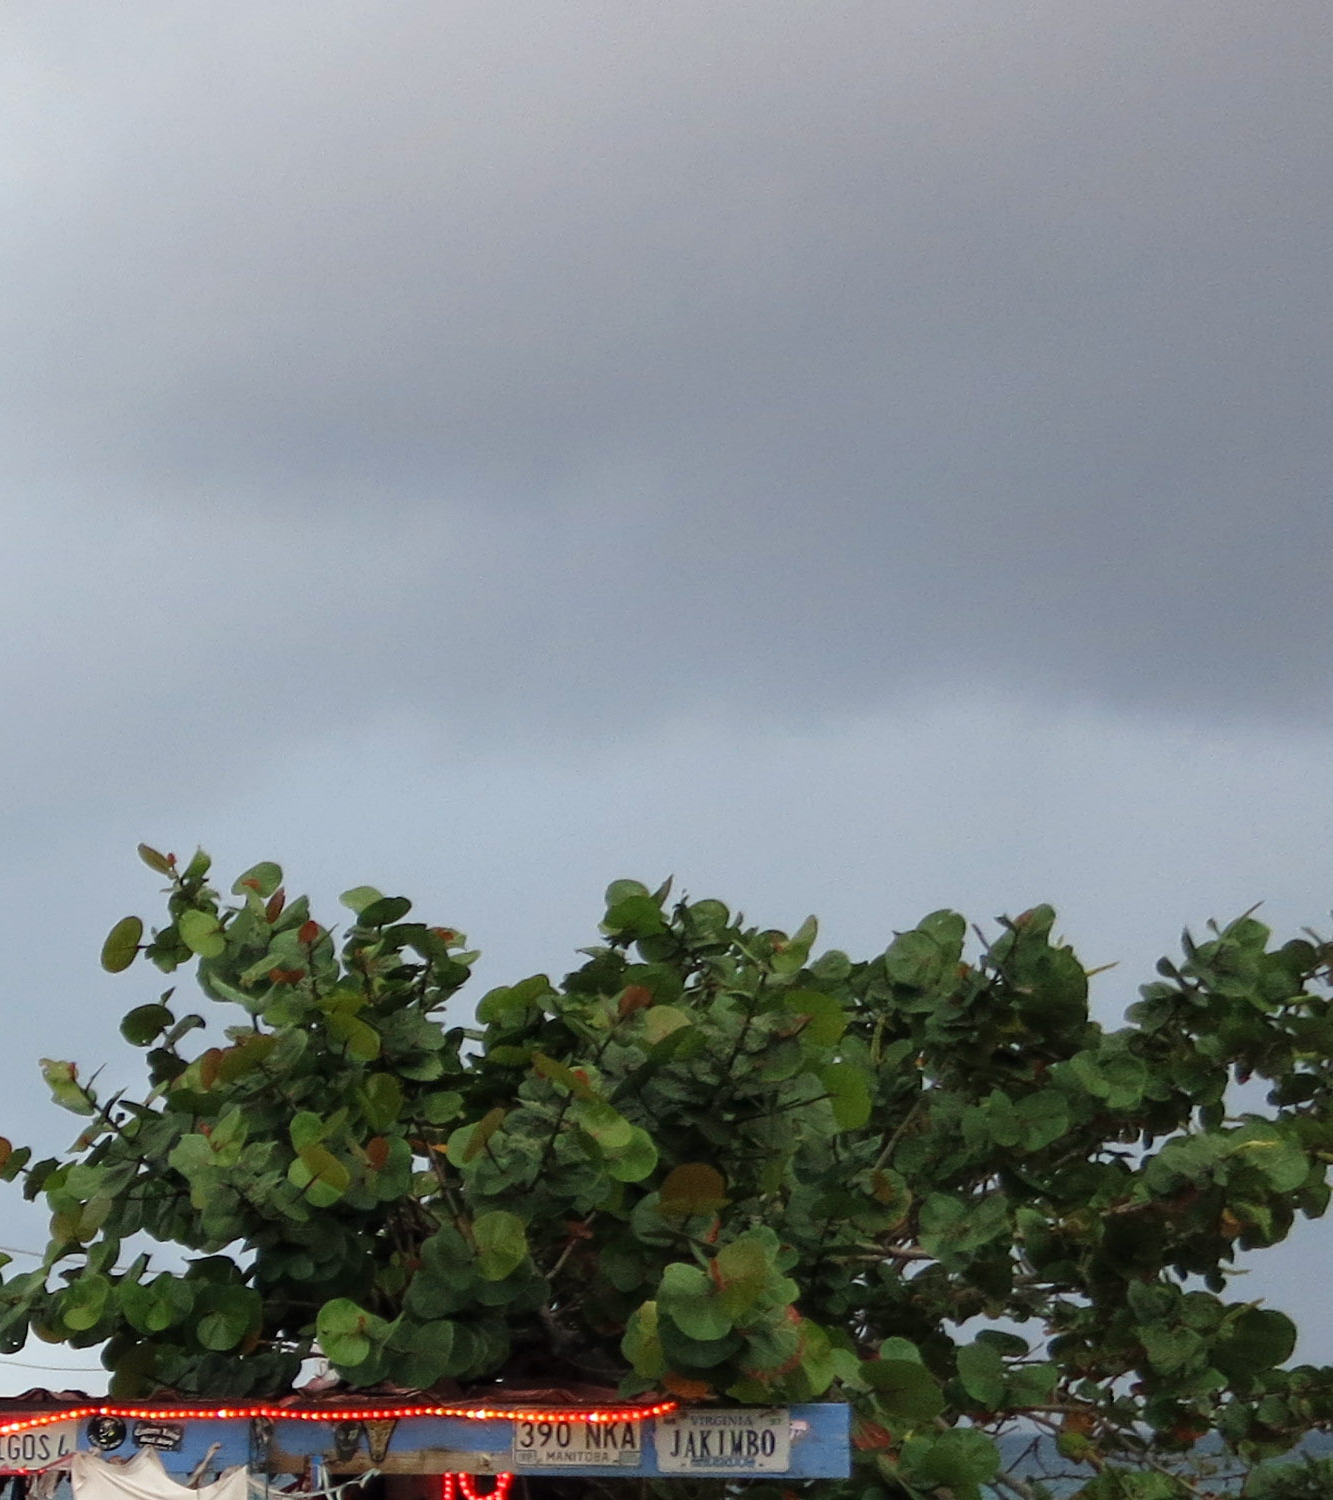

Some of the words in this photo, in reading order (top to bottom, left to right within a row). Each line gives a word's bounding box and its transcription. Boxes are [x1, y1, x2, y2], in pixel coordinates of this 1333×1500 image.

[690, 1415, 753, 1426] VIRGINIA
[519, 1420, 571, 1449] 390
[585, 1420, 635, 1449] NKA
[545, 1450, 610, 1462] MANITOBA
